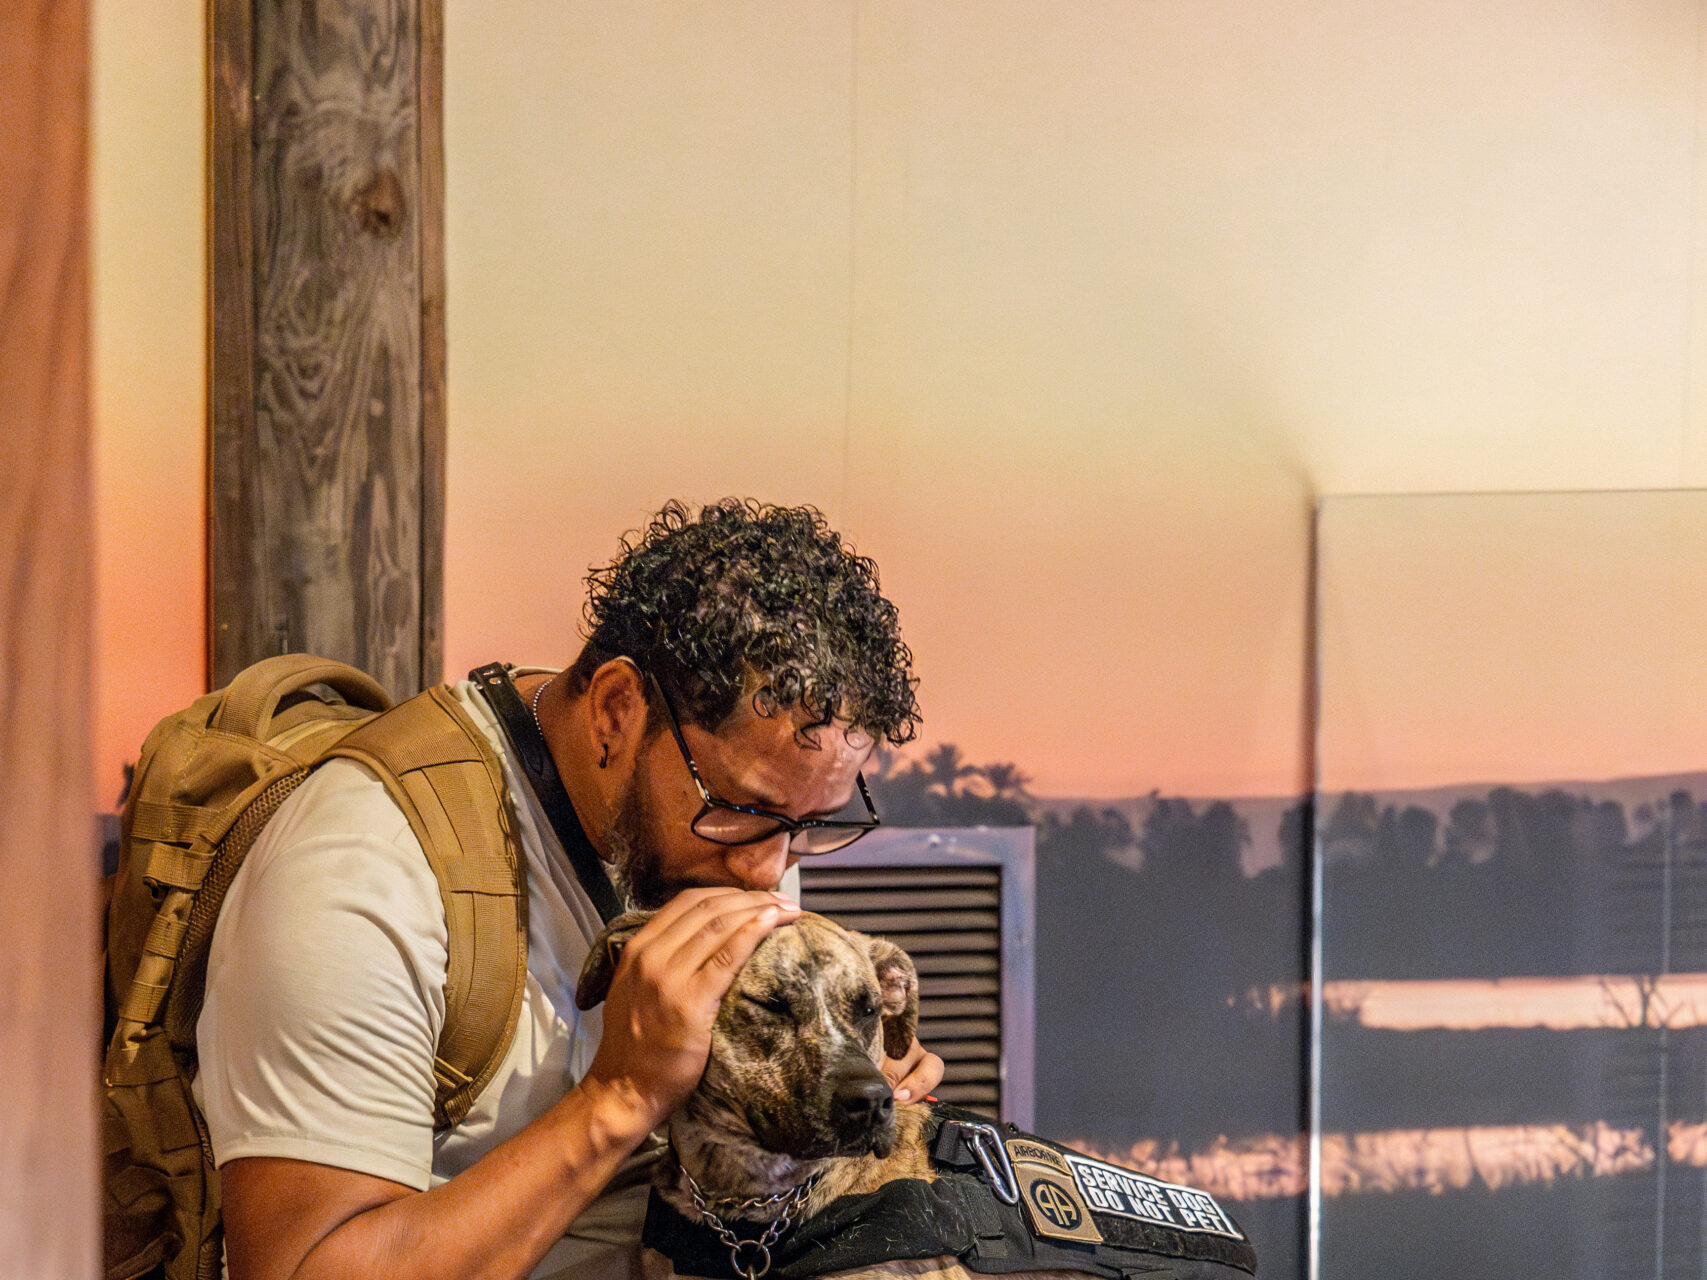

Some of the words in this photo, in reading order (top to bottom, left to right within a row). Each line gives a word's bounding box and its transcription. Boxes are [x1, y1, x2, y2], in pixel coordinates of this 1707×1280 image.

[1014, 1145, 1061, 1165] AIRBORNE
[1077, 1164, 1169, 1206] SERVICE
[1166, 1189, 1218, 1215] DOG
[1087, 1186, 1125, 1211] DO
[1126, 1195, 1176, 1224] NOT
[1178, 1208, 1226, 1232] PET
